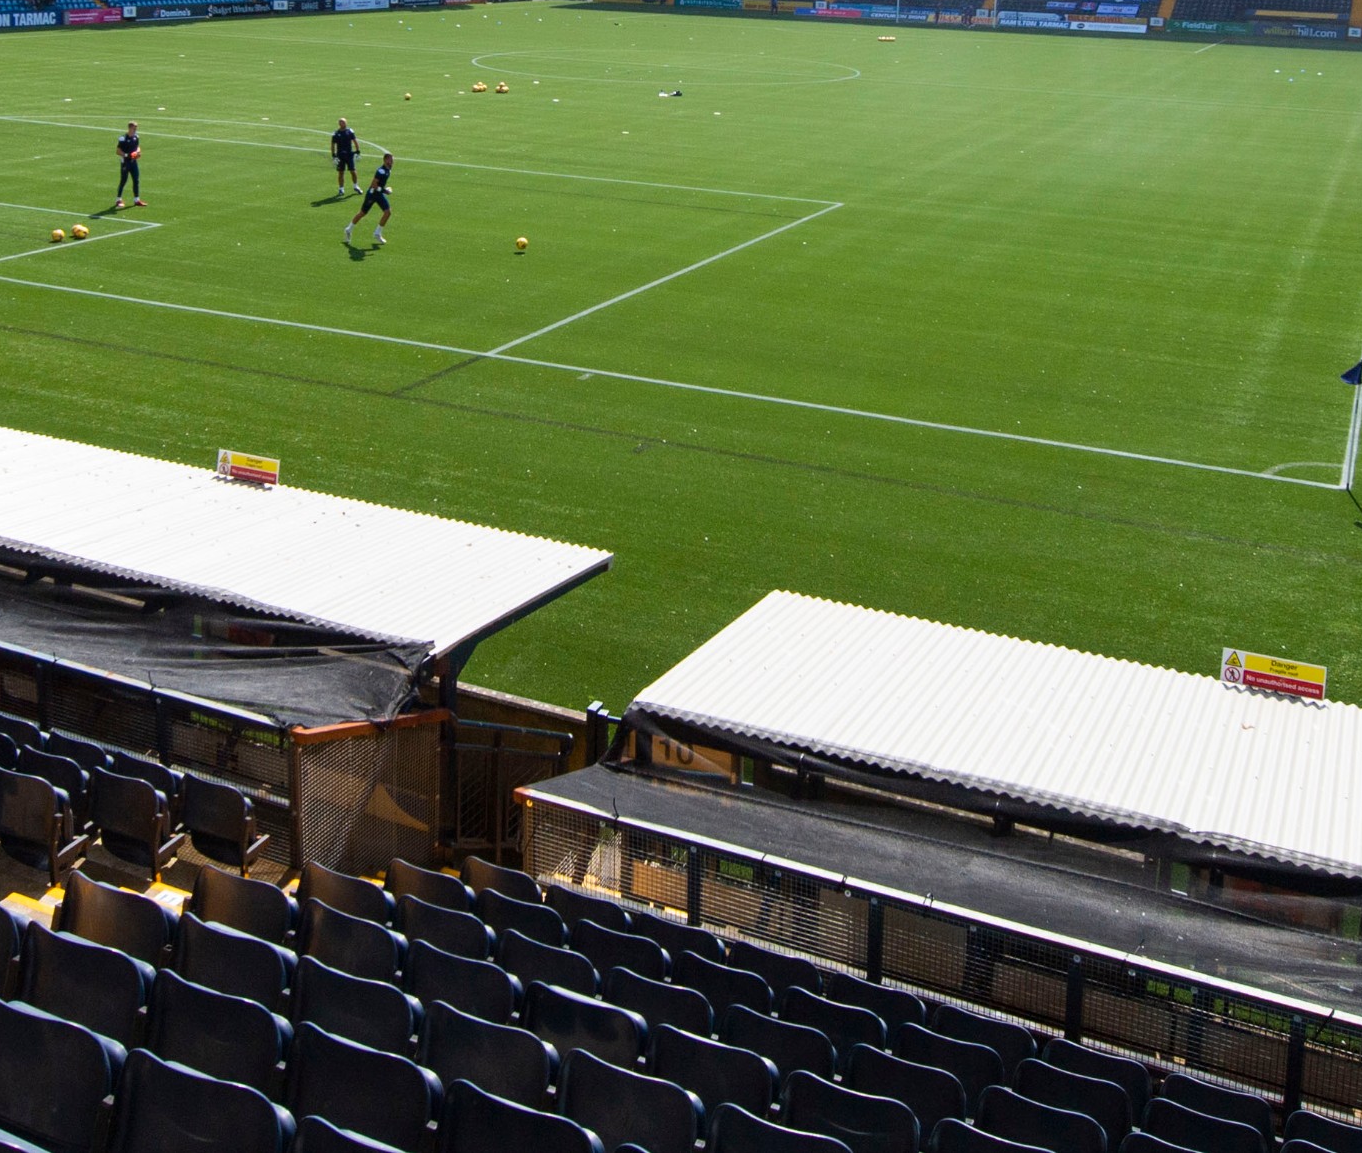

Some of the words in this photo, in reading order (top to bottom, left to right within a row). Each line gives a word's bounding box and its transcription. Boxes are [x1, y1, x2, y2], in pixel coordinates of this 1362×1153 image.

[161, 7, 191, 18] Domino's
[13, 11, 56, 27] TARMAC
[1181, 21, 1217, 31] FieldTurf
[1263, 25, 1337, 39] williamhill.com
[1271, 660, 1298, 671] Danger
[1256, 677, 1297, 690] unauthorised
[1297, 685, 1320, 695] access
